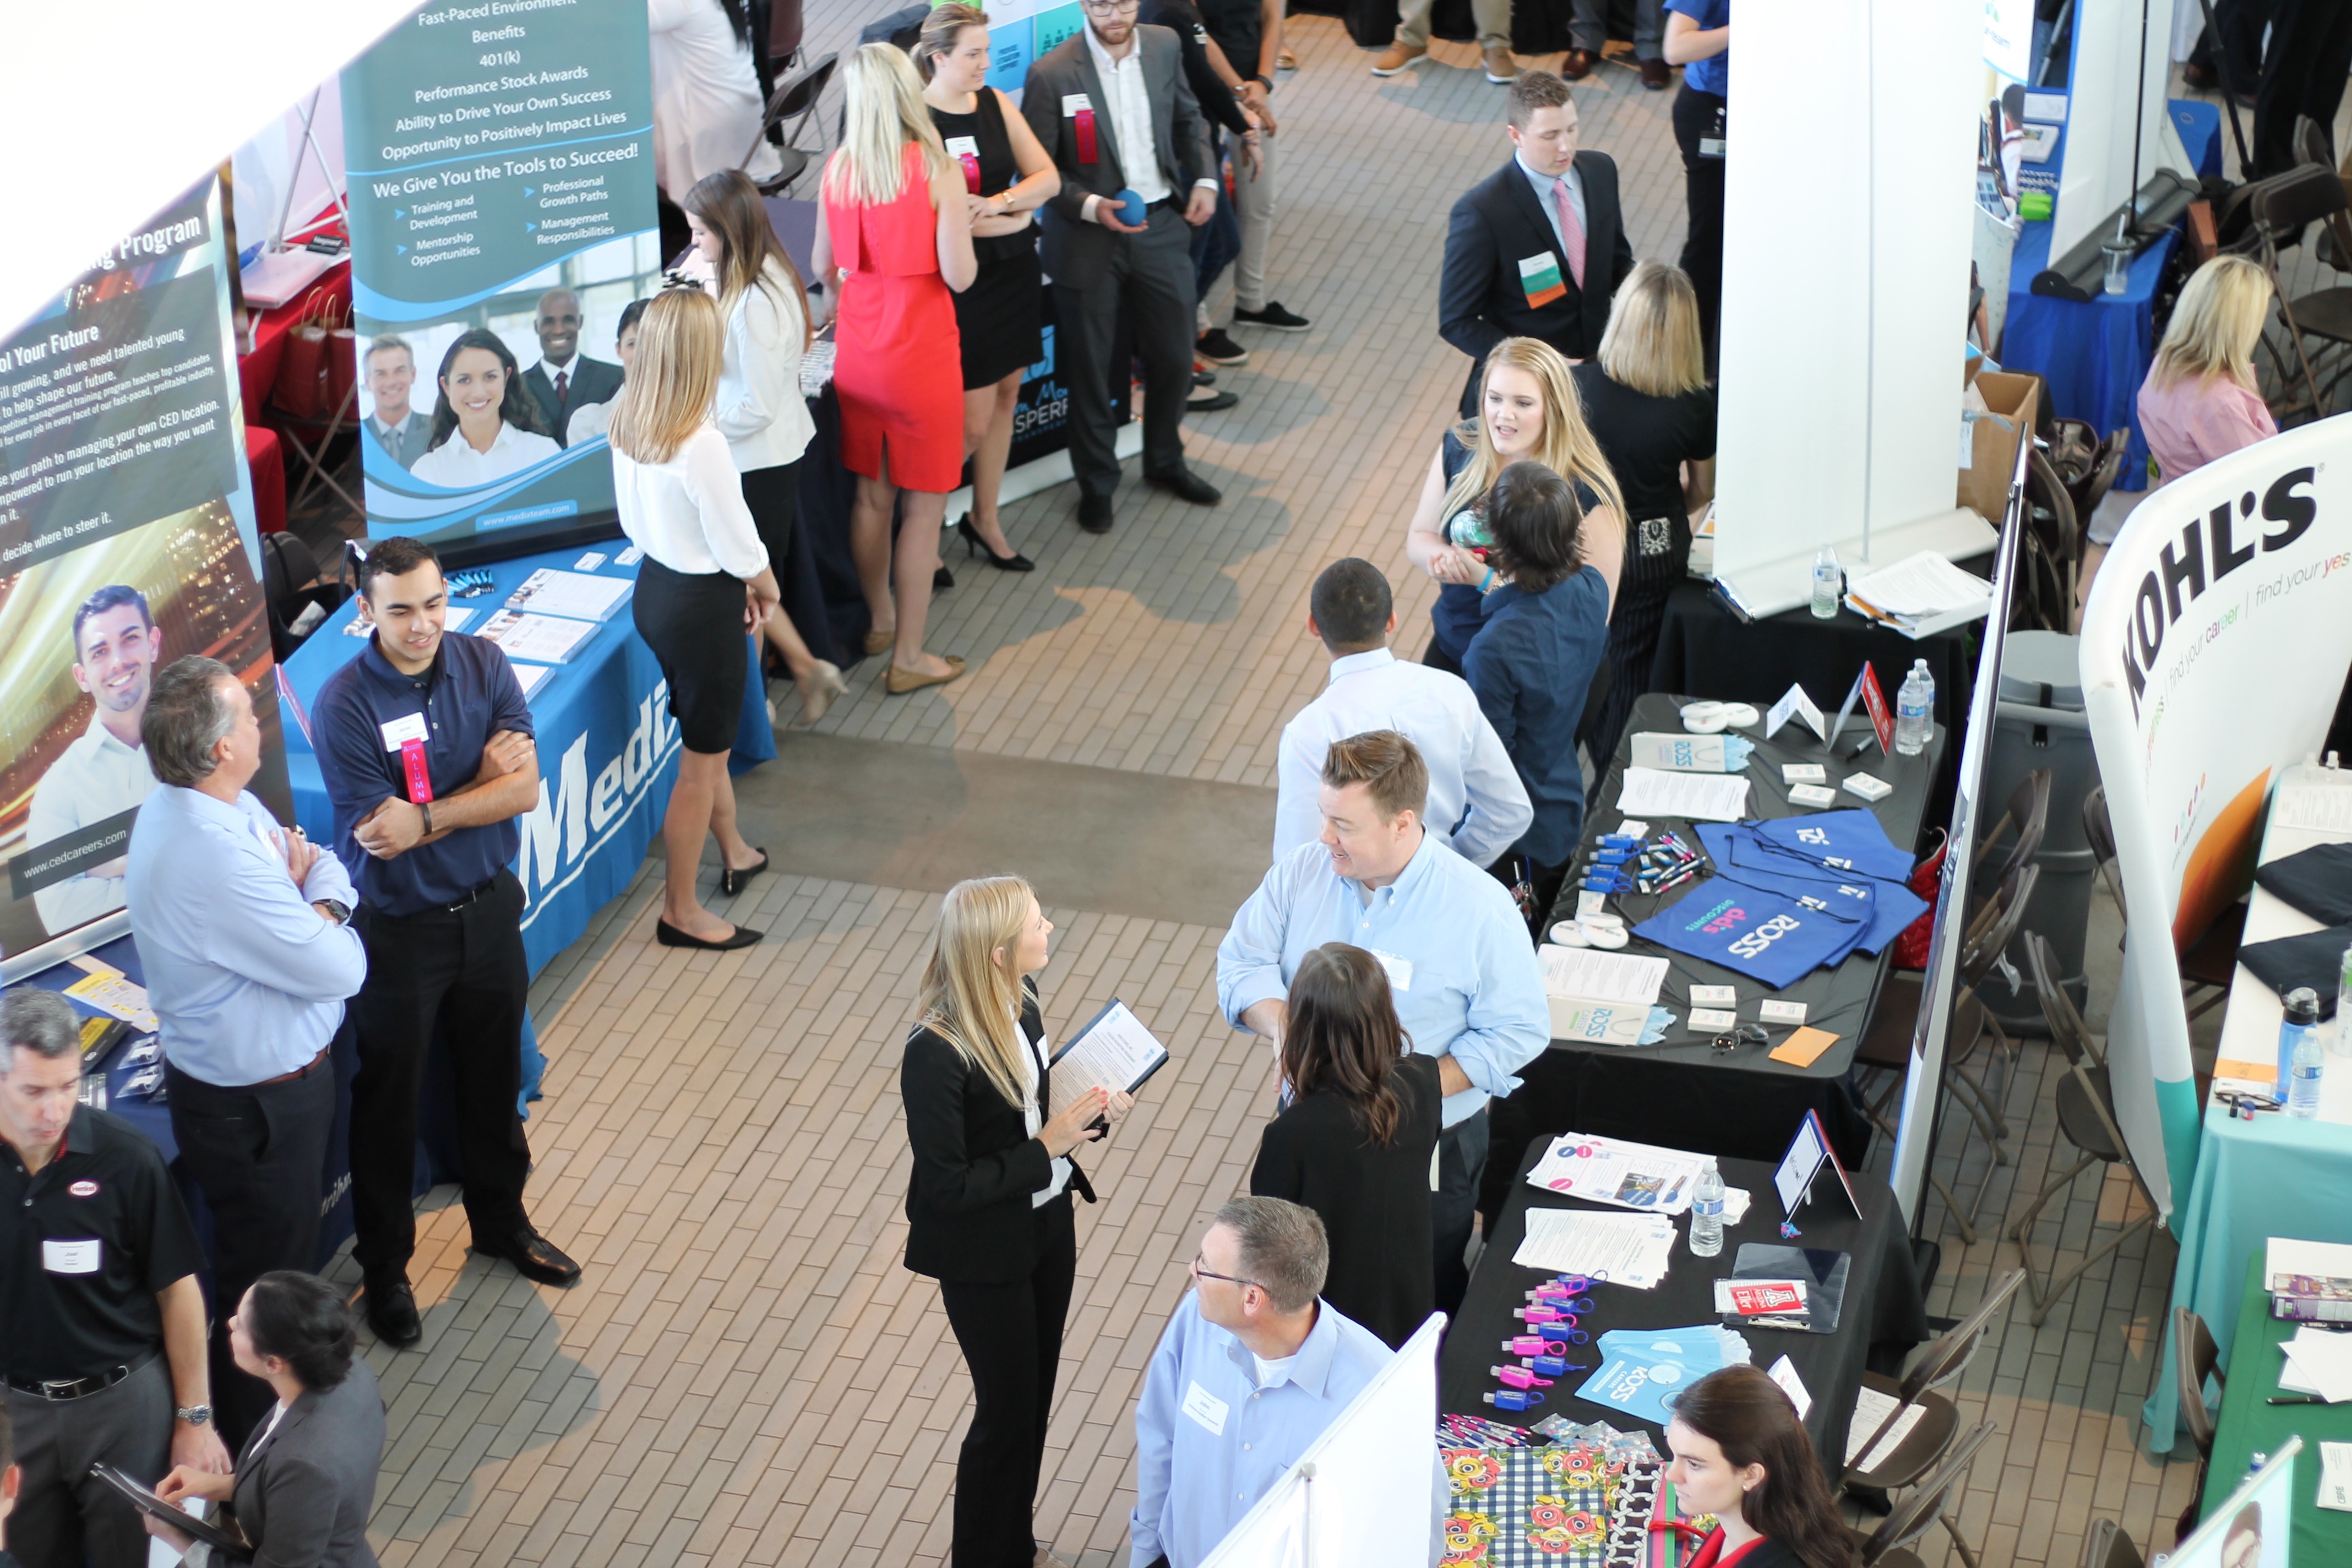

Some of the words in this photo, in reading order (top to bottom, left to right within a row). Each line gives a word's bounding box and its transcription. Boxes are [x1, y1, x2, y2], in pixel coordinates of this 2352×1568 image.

[418, 4, 489, 26] Fast-Paced
[472, 25, 526, 43] Benefits
[479, 50, 521, 67] 401(k)
[415, 81, 498, 104] Performance
[500, 73, 537, 91] Stock
[540, 66, 589, 84] Awards
[395, 115, 437, 132] Ability
[439, 113, 453, 124] to
[455, 106, 491, 122] Drive
[493, 101, 524, 116] Your
[526, 97, 558, 111] Own
[560, 89, 612, 106] Success
[382, 135, 462, 161] Opportunity
[464, 133, 478, 145] to
[481, 122, 543, 142] Positively
[546, 116, 591, 134] Impact
[594, 112, 627, 127] Lives
[373, 182, 400, 198] We
[403, 177, 438, 194] Give
[440, 170, 471, 187] You
[474, 165, 502, 181] the
[503, 157, 546, 176] Tools
[549, 156, 567, 170] to
[569, 143, 639, 167] Succeed!
[542, 175, 605, 194] Professional
[411, 200, 453, 215] Training
[454, 194, 475, 207] and
[540, 194, 578, 209] Growth
[580, 190, 608, 203] Paths
[119, 216, 200, 260] Program
[410, 210, 478, 231] Development
[537, 225, 615, 246] Responsibilities
[541, 211, 609, 230] Management
[411, 246, 481, 267] Opportunities
[416, 232, 474, 251] Mentorship
[12, 373, 52, 398] growing,
[53, 362, 72, 380] and
[74, 360, 88, 373] we
[90, 349, 112, 368] need
[114, 335, 153, 360] talented
[155, 328, 186, 349] young
[14, 342, 47, 366] Your
[50, 325, 99, 354] Future
[2, 406, 12, 418] to
[14, 398, 34, 414] help
[36, 386, 65, 406] shape
[67, 381, 82, 395] our
[84, 370, 116, 389] future.
[4, 435, 15, 446] for
[15, 429, 32, 442] every
[34, 423, 45, 437] job
[45, 421, 52, 431] in
[53, 414, 72, 427] every
[73, 407, 91, 421] facet
[92, 403, 100, 413] of
[100, 400, 112, 411] our
[113, 385, 153, 406] fast-paced,
[154, 374, 187, 395] profitable
[188, 366, 215, 382] industry.
[29, 399, 73, 422] management
[74, 391, 102, 406] training
[103, 380, 132, 399] program
[132, 371, 160, 386] teaches
[161, 367, 173, 377] top
[174, 353, 210, 373] candidates
[9, 466, 29, 486] your
[31, 456, 52, 477] path
[55, 452, 64, 465] to
[67, 435, 115, 461] managing
[116, 427, 136, 447] your
[138, 421, 157, 436] own
[159, 411, 179, 428] CED
[182, 400, 220, 422] location.
[44, 475, 54, 488] to
[56, 470, 72, 484] run
[74, 461, 95, 480] your
[97, 448, 133, 470] location
[135, 442, 151, 456] the
[153, 435, 172, 450] way
[173, 428, 190, 445] you
[192, 417, 216, 437] want
[9, 508, 20, 521] it.
[483, 505, 569, 526] www.medixteam.com
[3, 541, 33, 562] decide
[34, 529, 62, 549] where
[63, 526, 73, 538] to
[75, 516, 99, 534] steer
[101, 511, 112, 525] it.
[2122, 466, 2317, 732] KOHL'S
[2206, 604, 2240, 644] career
[2256, 579, 2283, 605] find
[2285, 562, 2320, 595] your
[2322, 552, 2351, 578] yes
[411, 753, 426, 803] ALUMN
[518, 678, 677, 910] Medi
[24, 829, 127, 879] www.cedcareers.com
[1685, 899, 1735, 932] DISCOUNTS
[1728, 914, 1801, 960] ROSS
[1736, 1291, 1752, 1309] Eller
[1608, 1370, 1627, 1389] CAREERS
[1609, 1365, 1648, 1403] ROSS
